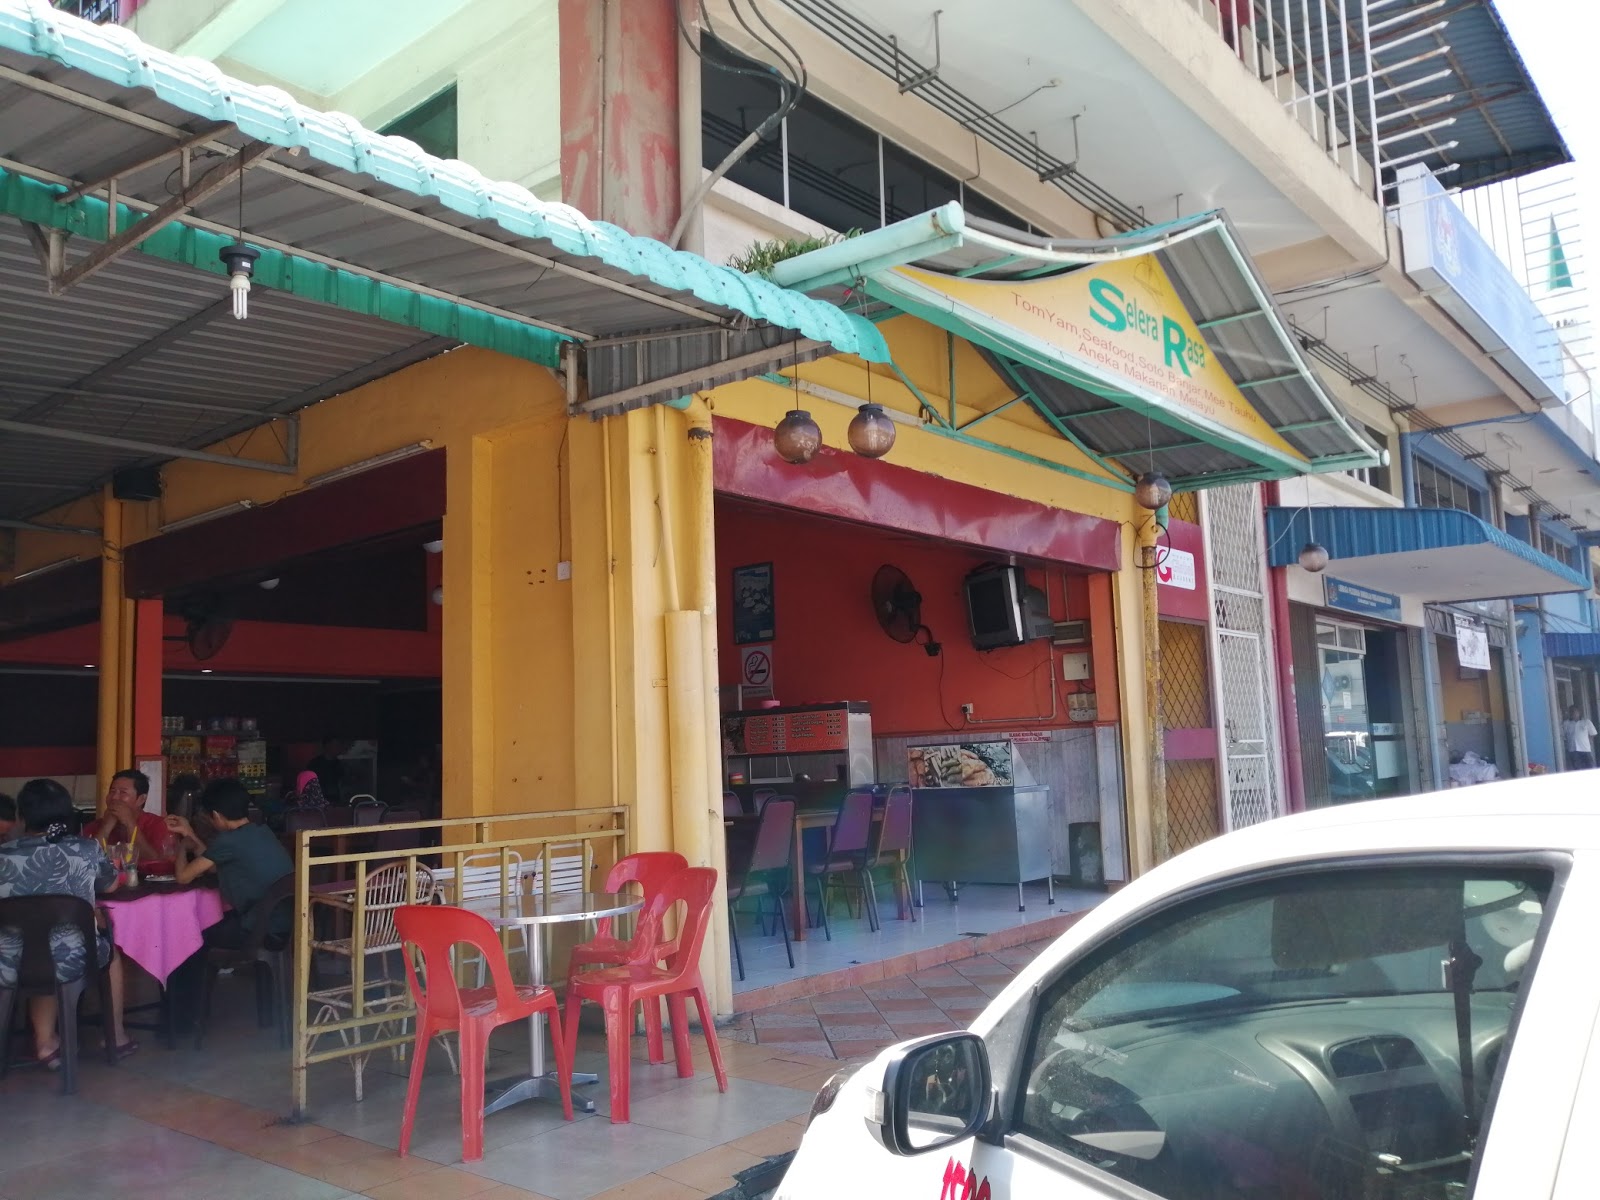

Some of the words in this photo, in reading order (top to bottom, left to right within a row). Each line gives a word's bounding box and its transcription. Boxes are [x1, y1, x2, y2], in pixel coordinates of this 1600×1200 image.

[1088, 277, 1159, 342] Selera
[1162, 314, 1206, 379] Rasa
[1078, 341, 1120, 370] Aneka
[1124, 361, 1176, 398] Makanan
[1179, 389, 1216, 416] Melayu
[1228, 400, 1257, 423] Tauhu
